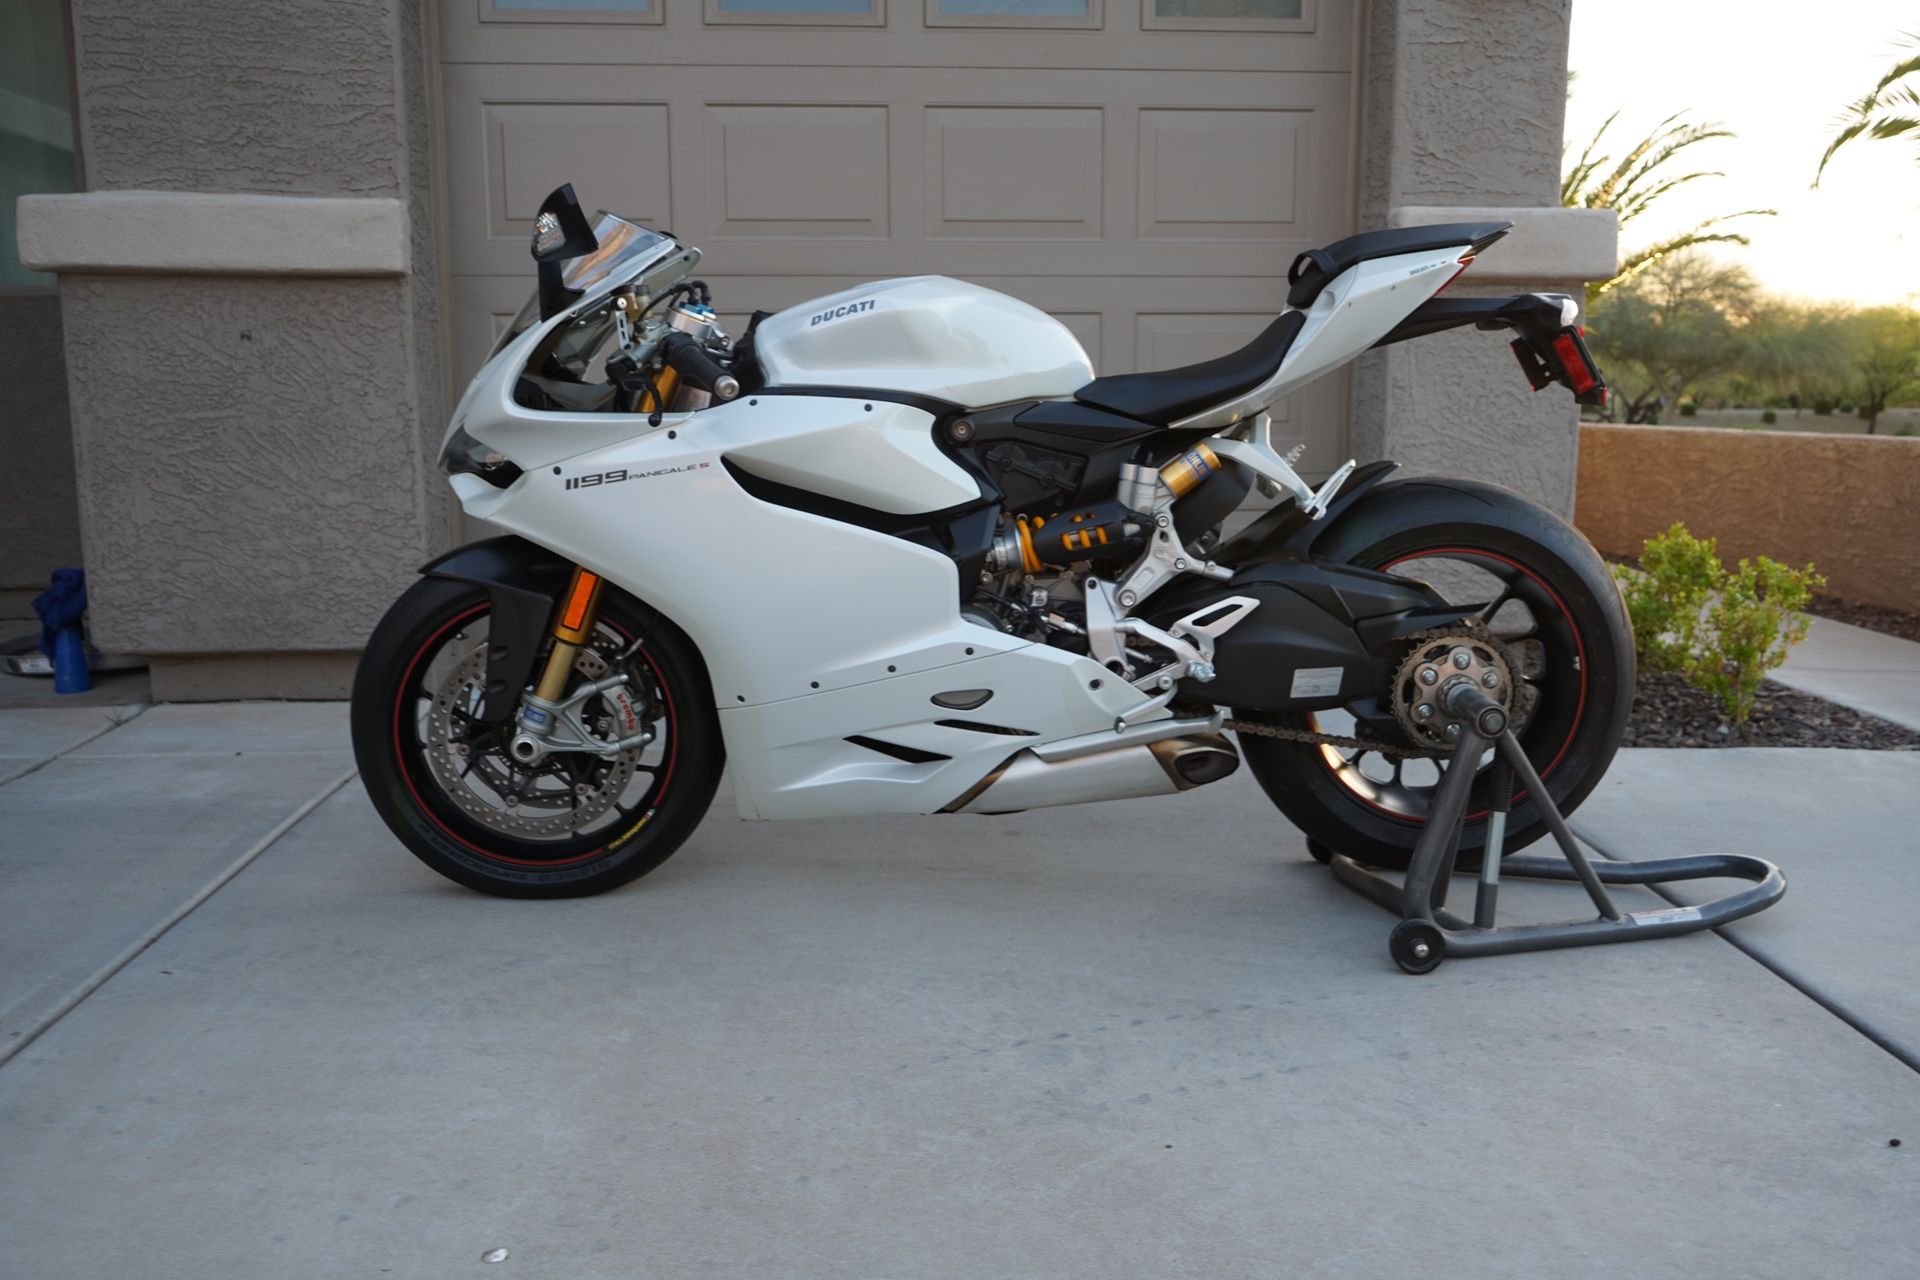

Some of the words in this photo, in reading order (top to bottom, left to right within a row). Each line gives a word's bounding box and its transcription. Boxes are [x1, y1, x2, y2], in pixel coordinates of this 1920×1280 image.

[810, 299, 876, 326] DUCATI
[565, 469, 628, 490] 1199
[616, 692, 635, 731] brembo
